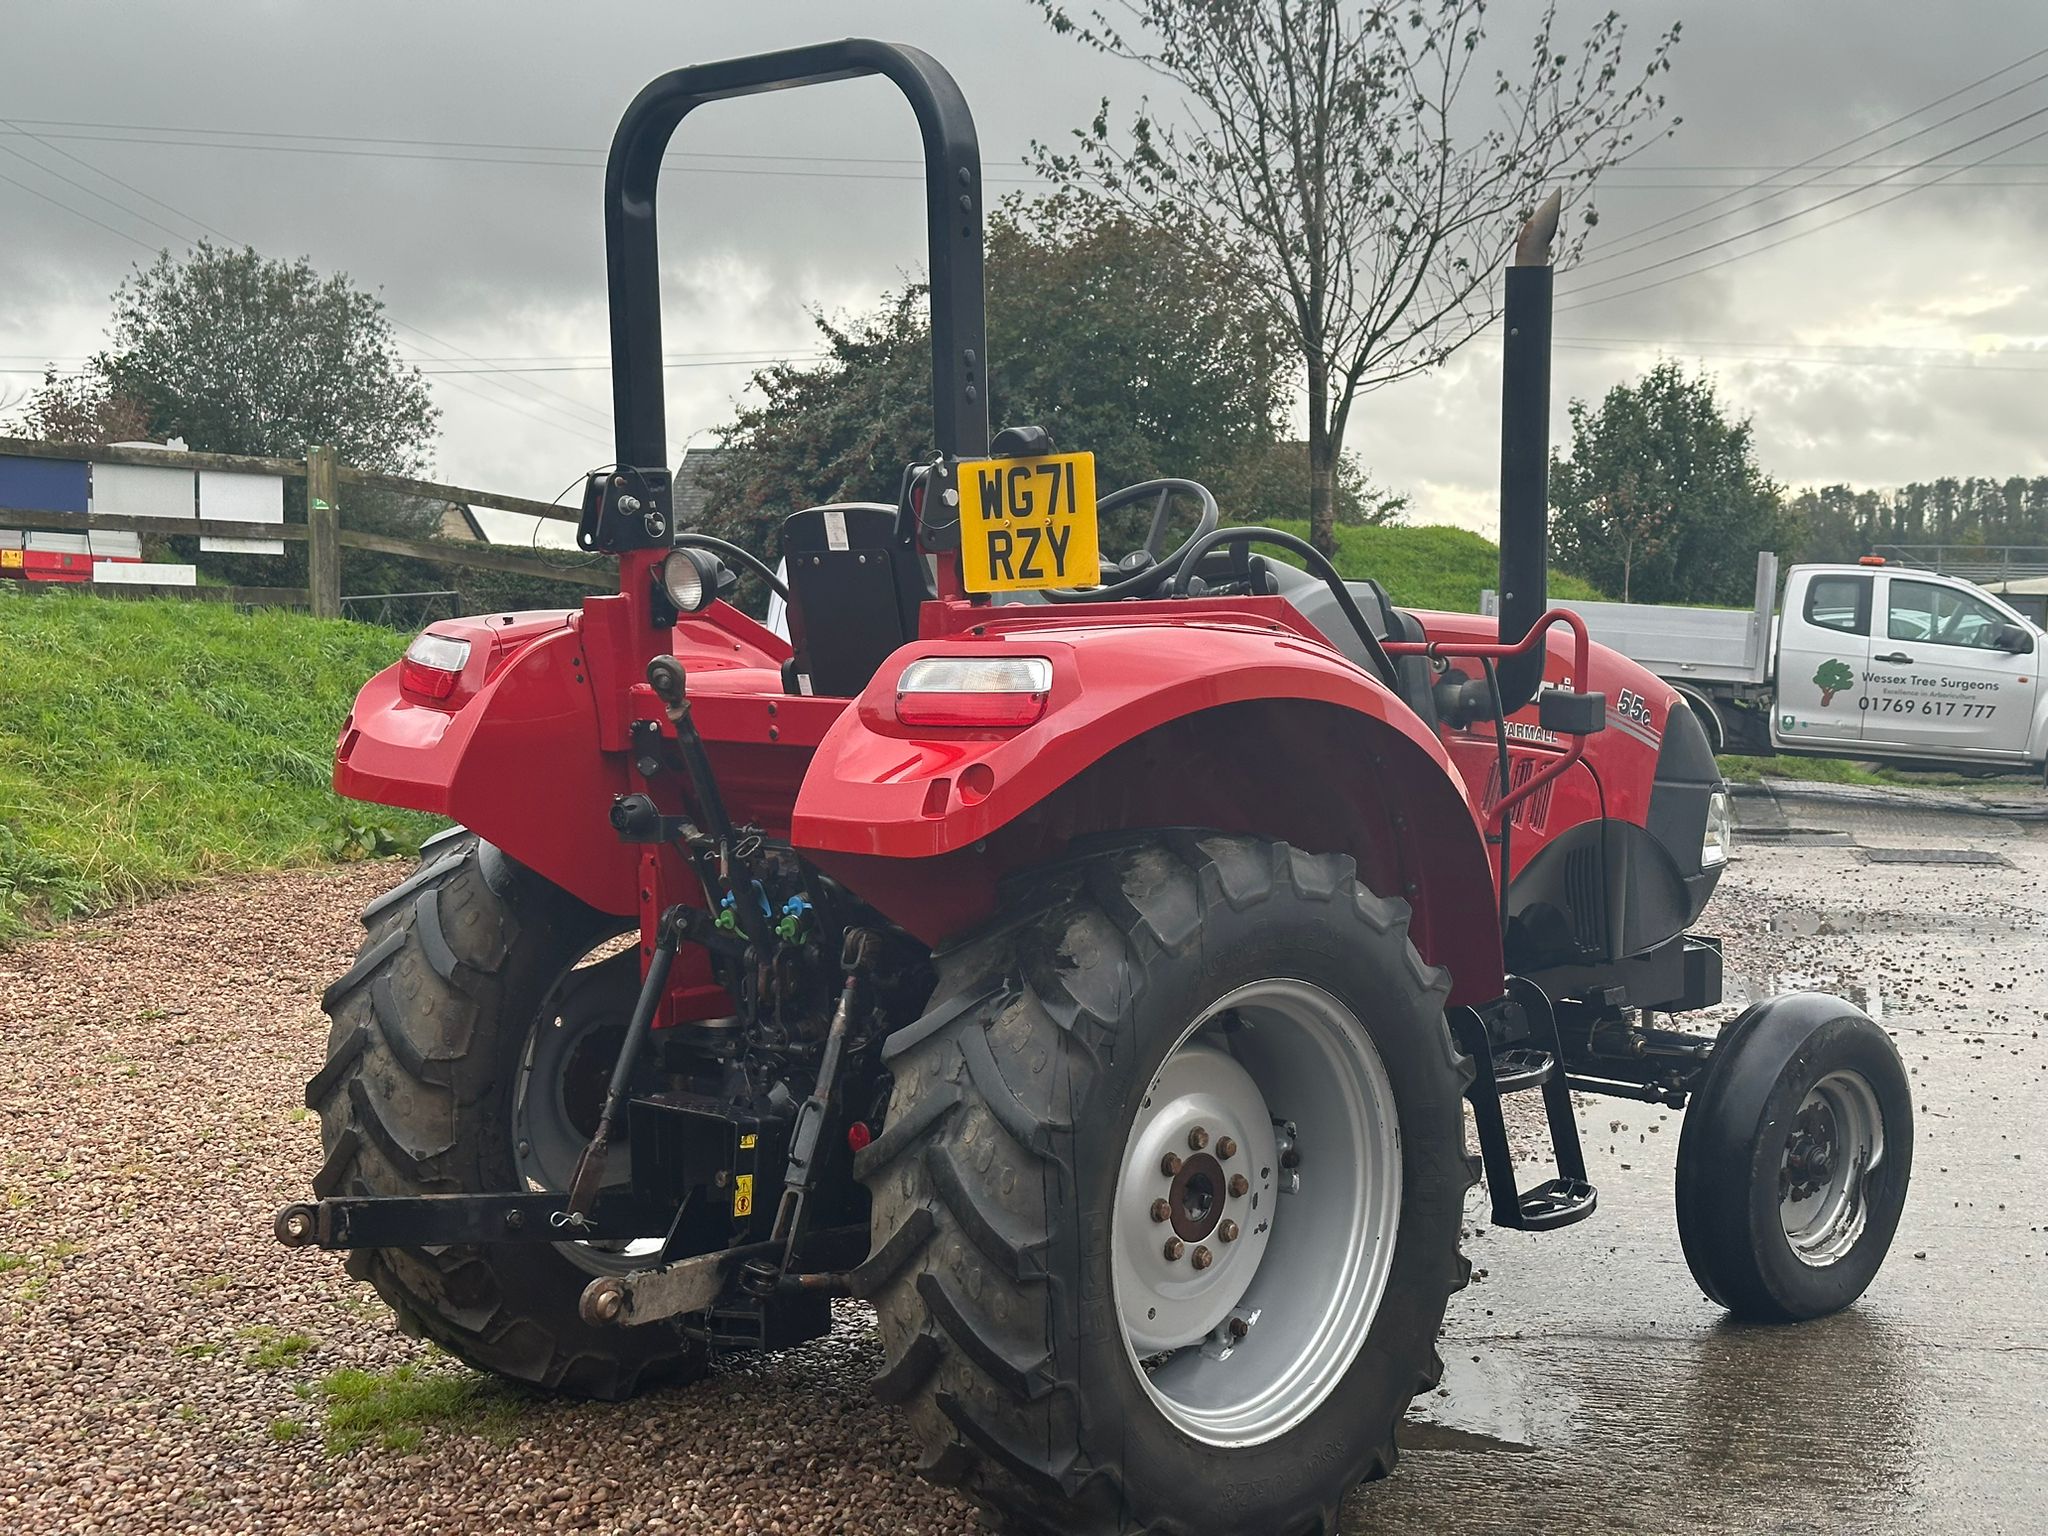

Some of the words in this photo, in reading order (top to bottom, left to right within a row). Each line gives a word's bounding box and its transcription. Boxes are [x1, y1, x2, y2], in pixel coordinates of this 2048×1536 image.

[978, 462, 1076, 520] WG71
[987, 525, 1071, 580] RZY
[1861, 671, 1907, 685] Wessex
[1910, 675, 1937, 687] Tree
[1940, 677, 2000, 691] Surgeons
[1858, 696, 1915, 713] 01769
[1921, 701, 1956, 716] 617
[1962, 704, 1997, 719] 777
